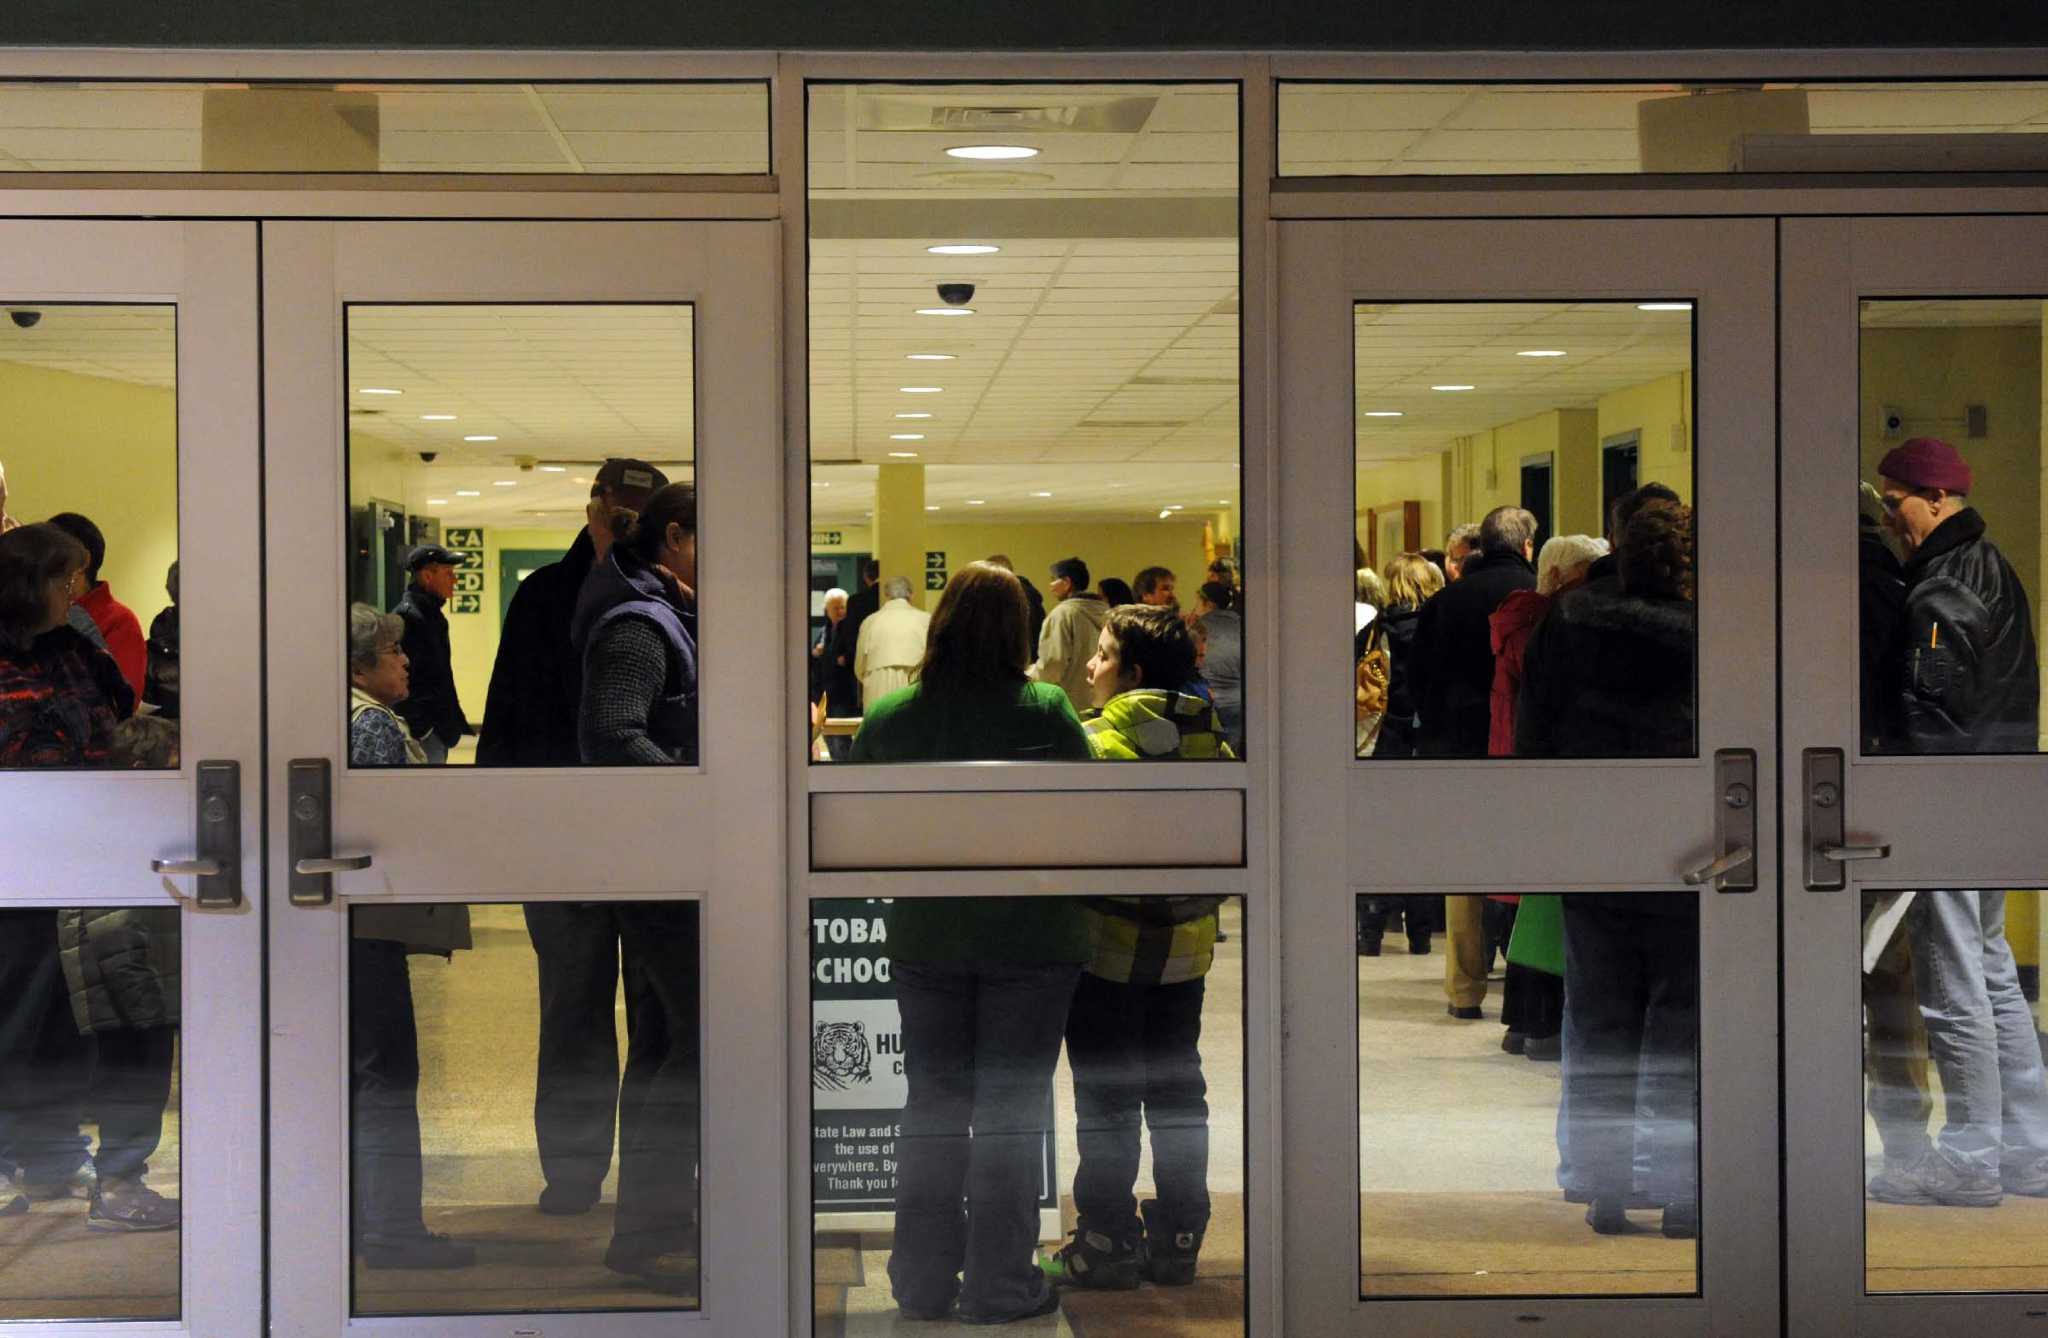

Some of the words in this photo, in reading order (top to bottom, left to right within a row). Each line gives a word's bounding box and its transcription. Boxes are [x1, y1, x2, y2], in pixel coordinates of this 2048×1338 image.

[465, 530, 481, 547] A
[465, 573, 480, 591] D
[813, 918, 887, 944] TOBA
[813, 957, 891, 984] CHOO
[842, 1125, 866, 1138] Law
[868, 1125, 891, 1138] and
[834, 1142, 854, 1155] the
[858, 1144, 879, 1155] use
[882, 1142, 895, 1155] of
[883, 1159, 898, 1174] By
[827, 1177, 863, 1191] Thank
[866, 1179, 888, 1192] you
